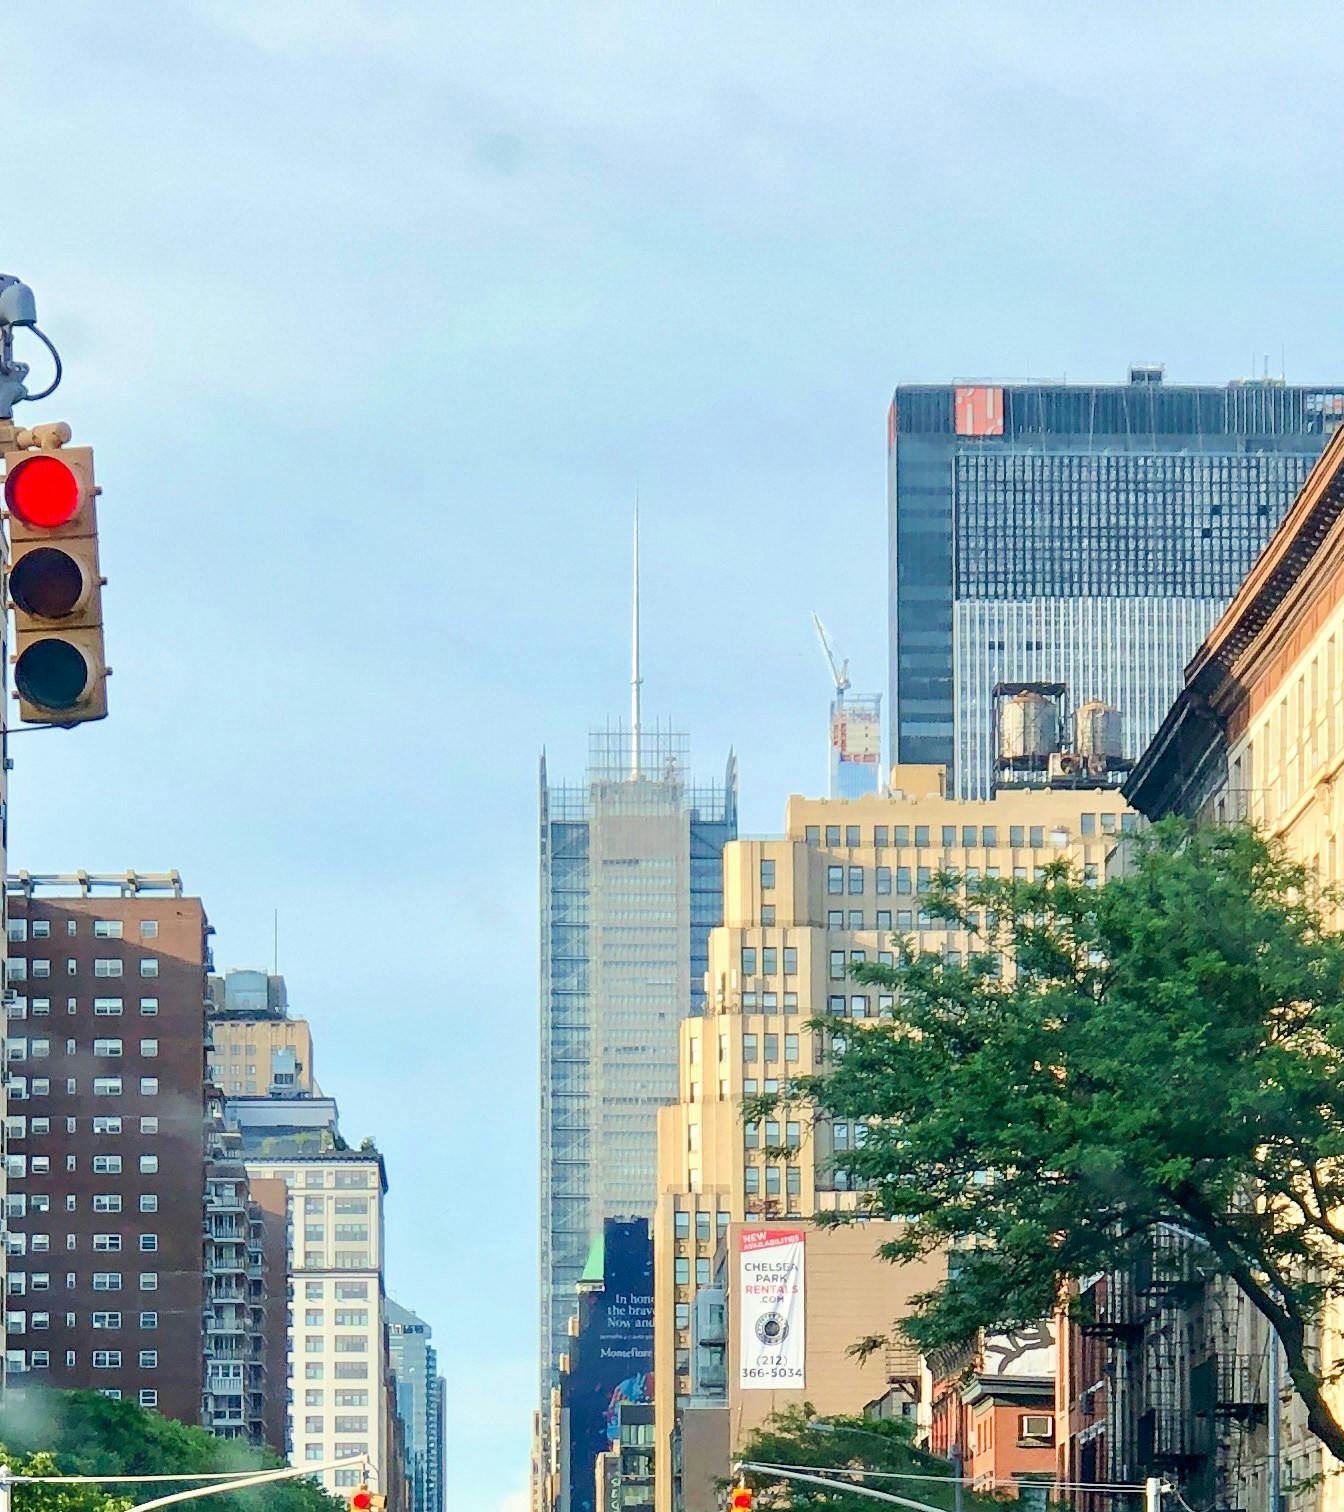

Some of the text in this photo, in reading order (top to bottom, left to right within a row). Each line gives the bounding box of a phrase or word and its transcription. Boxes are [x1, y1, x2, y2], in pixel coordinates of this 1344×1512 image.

[742, 1231, 767, 1244] NEW
[743, 1234, 800, 1251] AVAILABILITIES
[744, 1262, 798, 1272] CHELSEA
[756, 1273, 788, 1283] PARK
[616, 1293, 627, 1304] In
[760, 1295, 784, 1304] .COM
[607, 1305, 654, 1316] the brav
[756, 1355, 787, 1366] (212)
[742, 1367, 803, 1378] 366-5034
